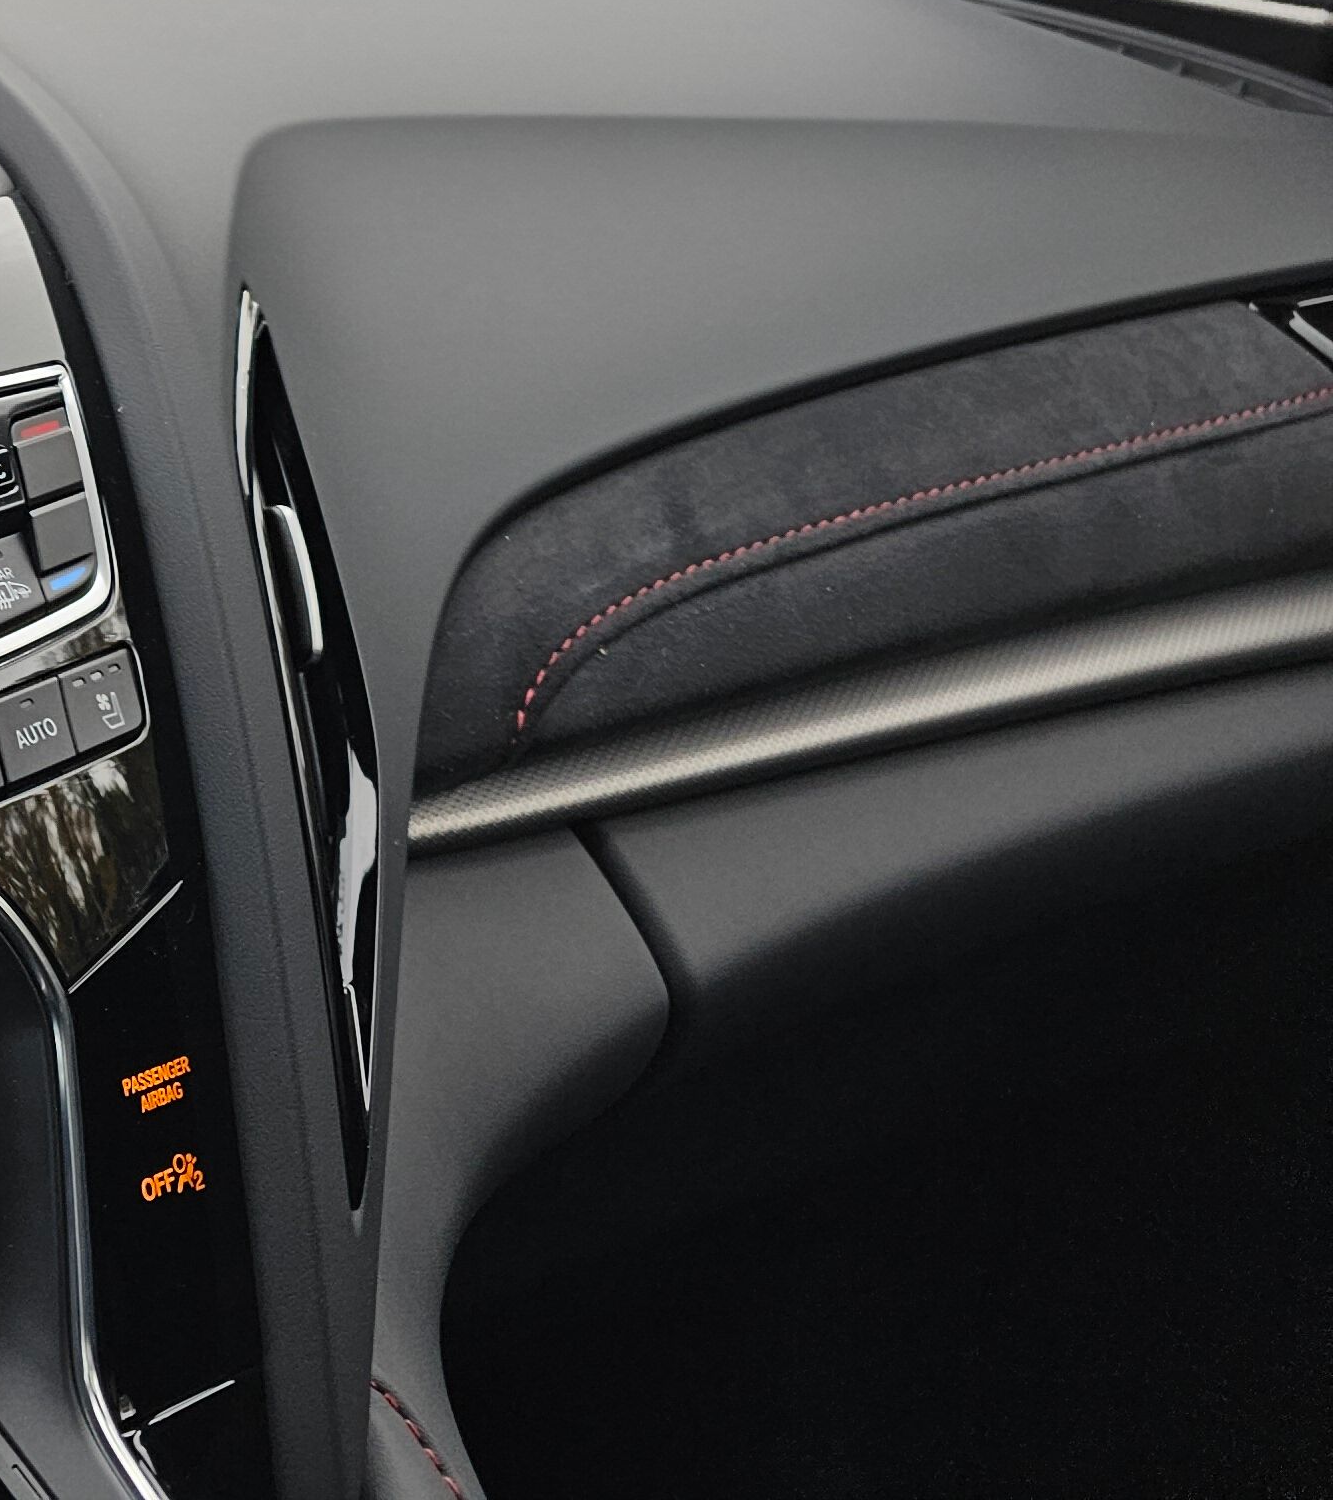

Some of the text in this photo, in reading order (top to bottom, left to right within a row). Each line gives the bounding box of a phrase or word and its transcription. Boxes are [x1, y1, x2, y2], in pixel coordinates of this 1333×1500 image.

[14, 717, 59, 751] AUTO
[121, 1055, 192, 1097] PASSENGER
[139, 1080, 184, 1114] AIRBAG
[140, 1167, 176, 1202] OFF
